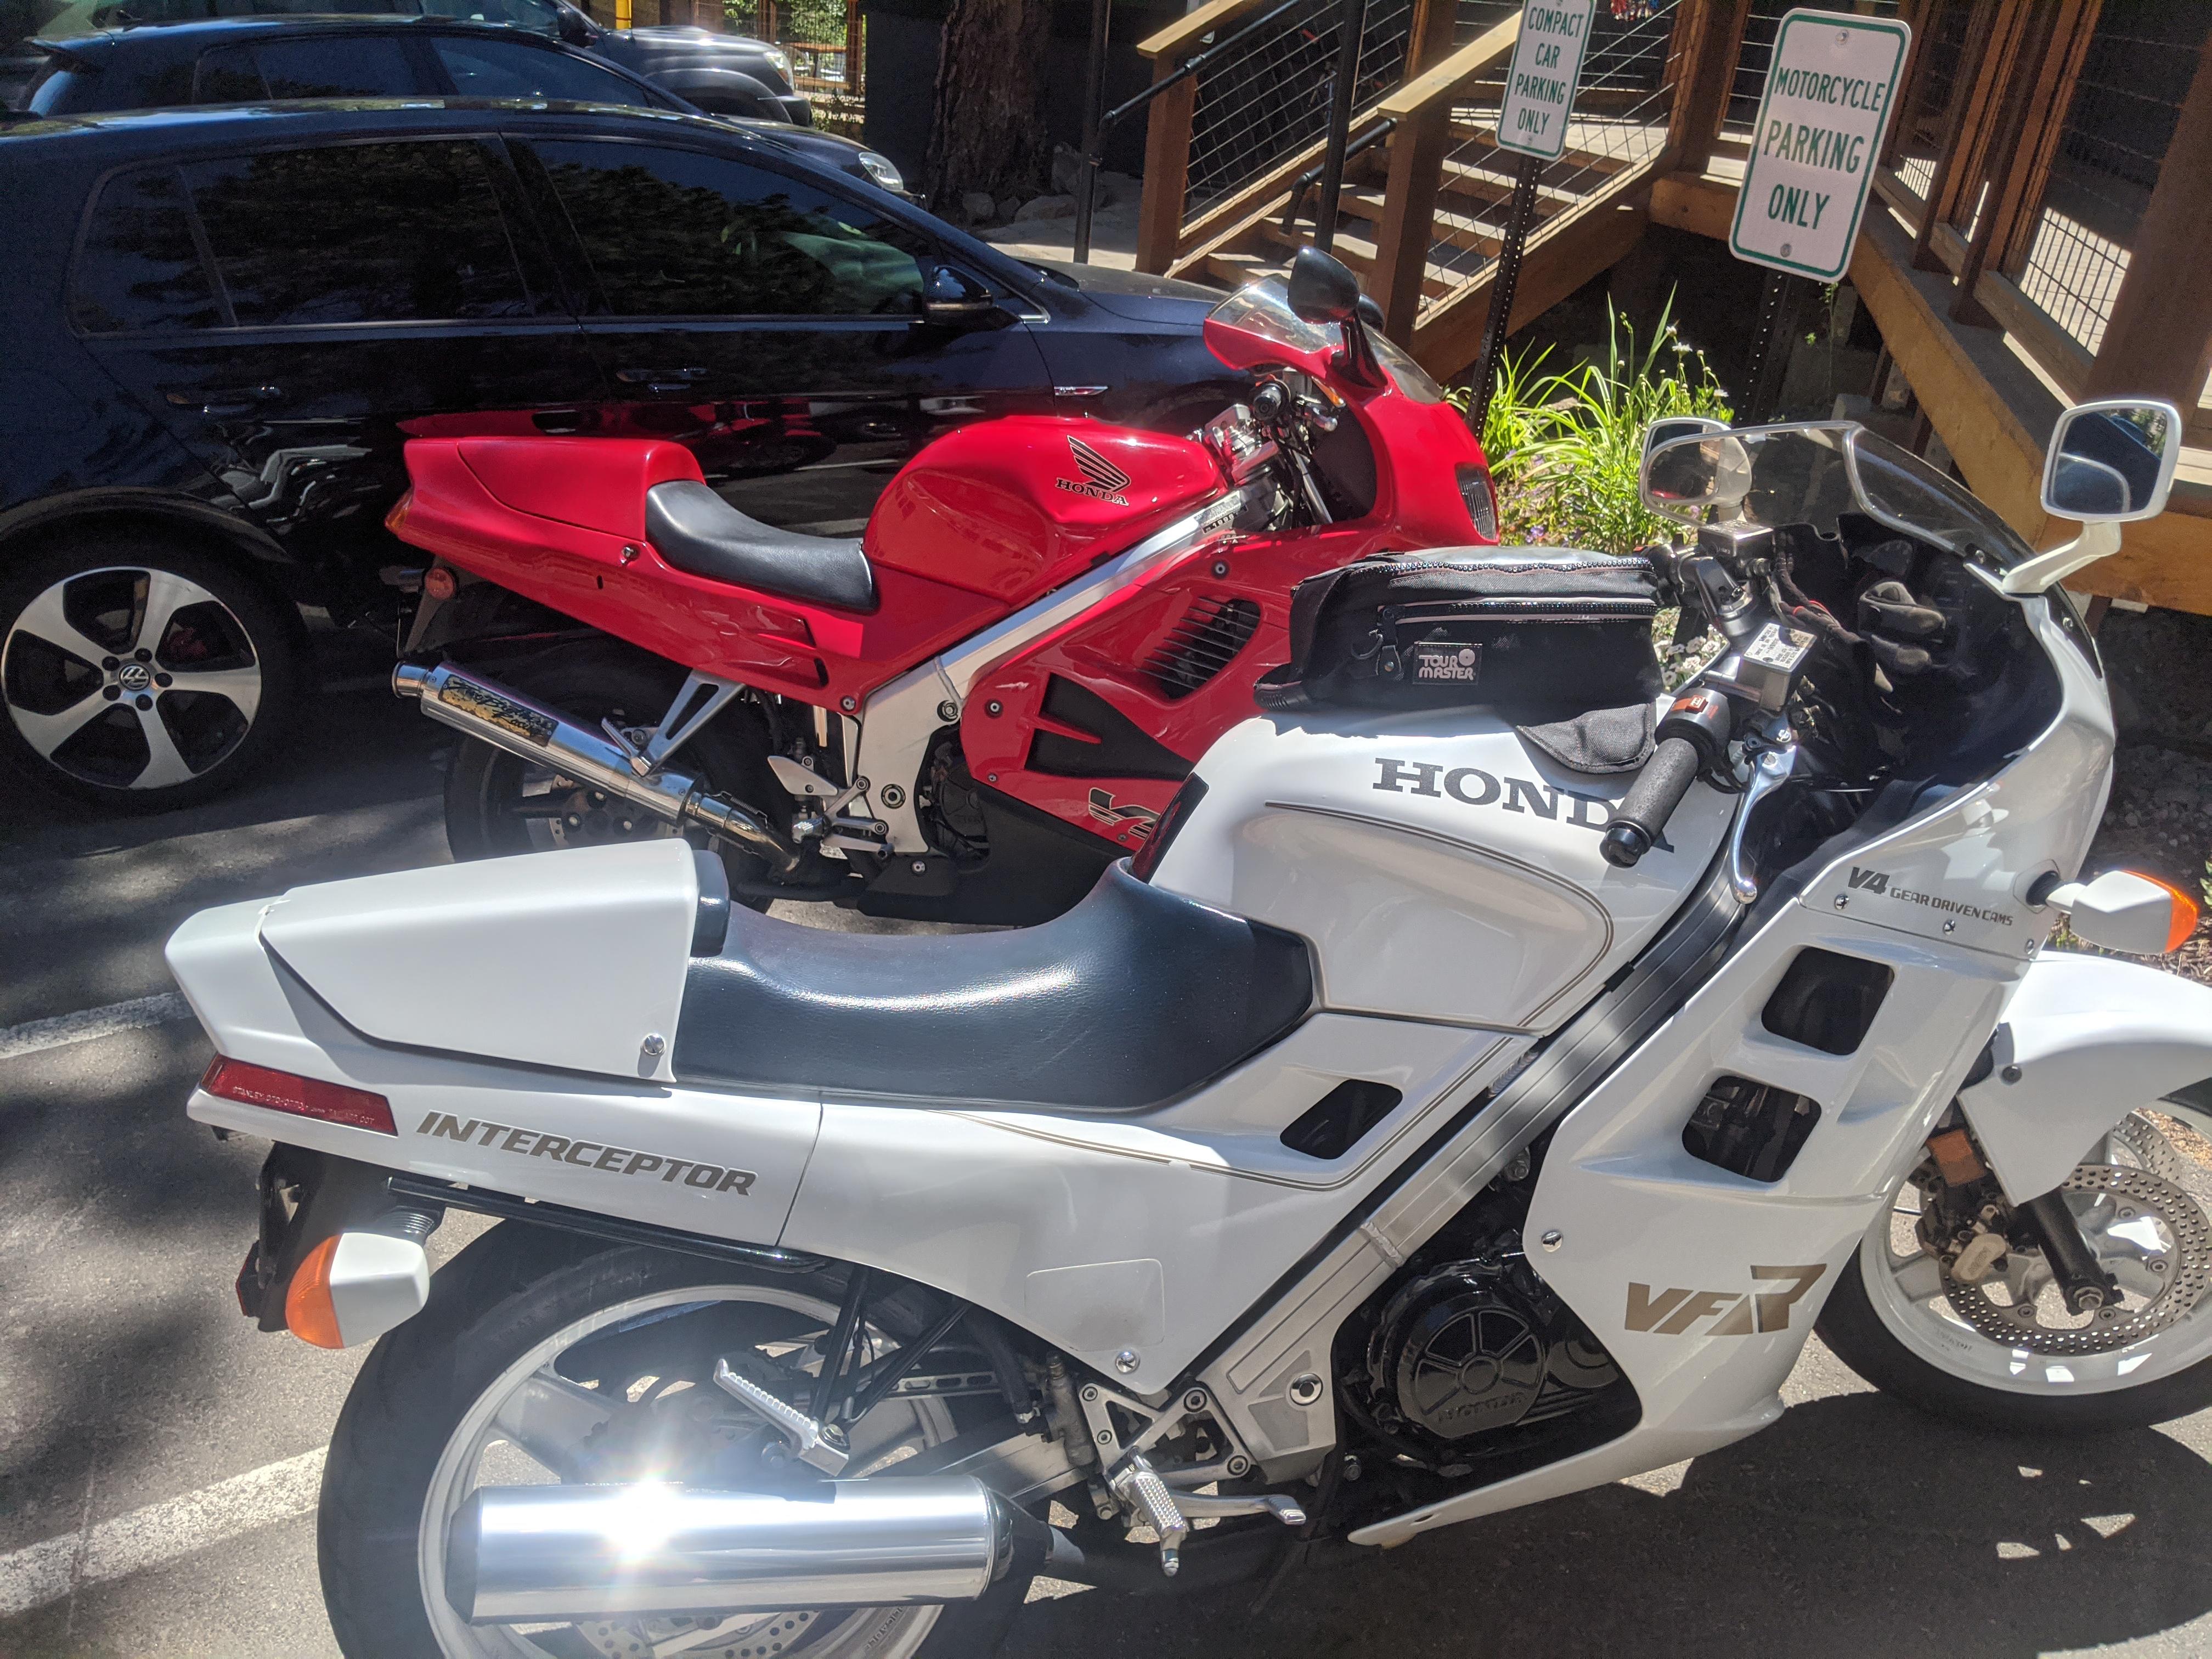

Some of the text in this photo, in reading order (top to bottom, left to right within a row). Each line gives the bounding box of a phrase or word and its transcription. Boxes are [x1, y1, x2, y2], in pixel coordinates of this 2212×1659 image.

[1528, 7, 1584, 38] COMPACT
[1535, 43, 1560, 69] CAR
[1514, 74, 1566, 105] PARKING
[1774, 67, 1886, 111] MOTORCYCLE
[1517, 108, 1550, 135] ONLY
[1763, 120, 1864, 173] PARKING
[1768, 184, 1830, 230] ONLY
[1056, 477, 1129, 506] HONDA
[1418, 655, 1459, 669] TOUR
[1418, 667, 1474, 680] MASTER
[1373, 758, 1674, 853] HOND
[1848, 867, 2013, 926] V4 GEAR DRIVEN CAMS
[415, 1110, 758, 1196] INTERCEPTOR
[1624, 1263, 1827, 1336] VFR
